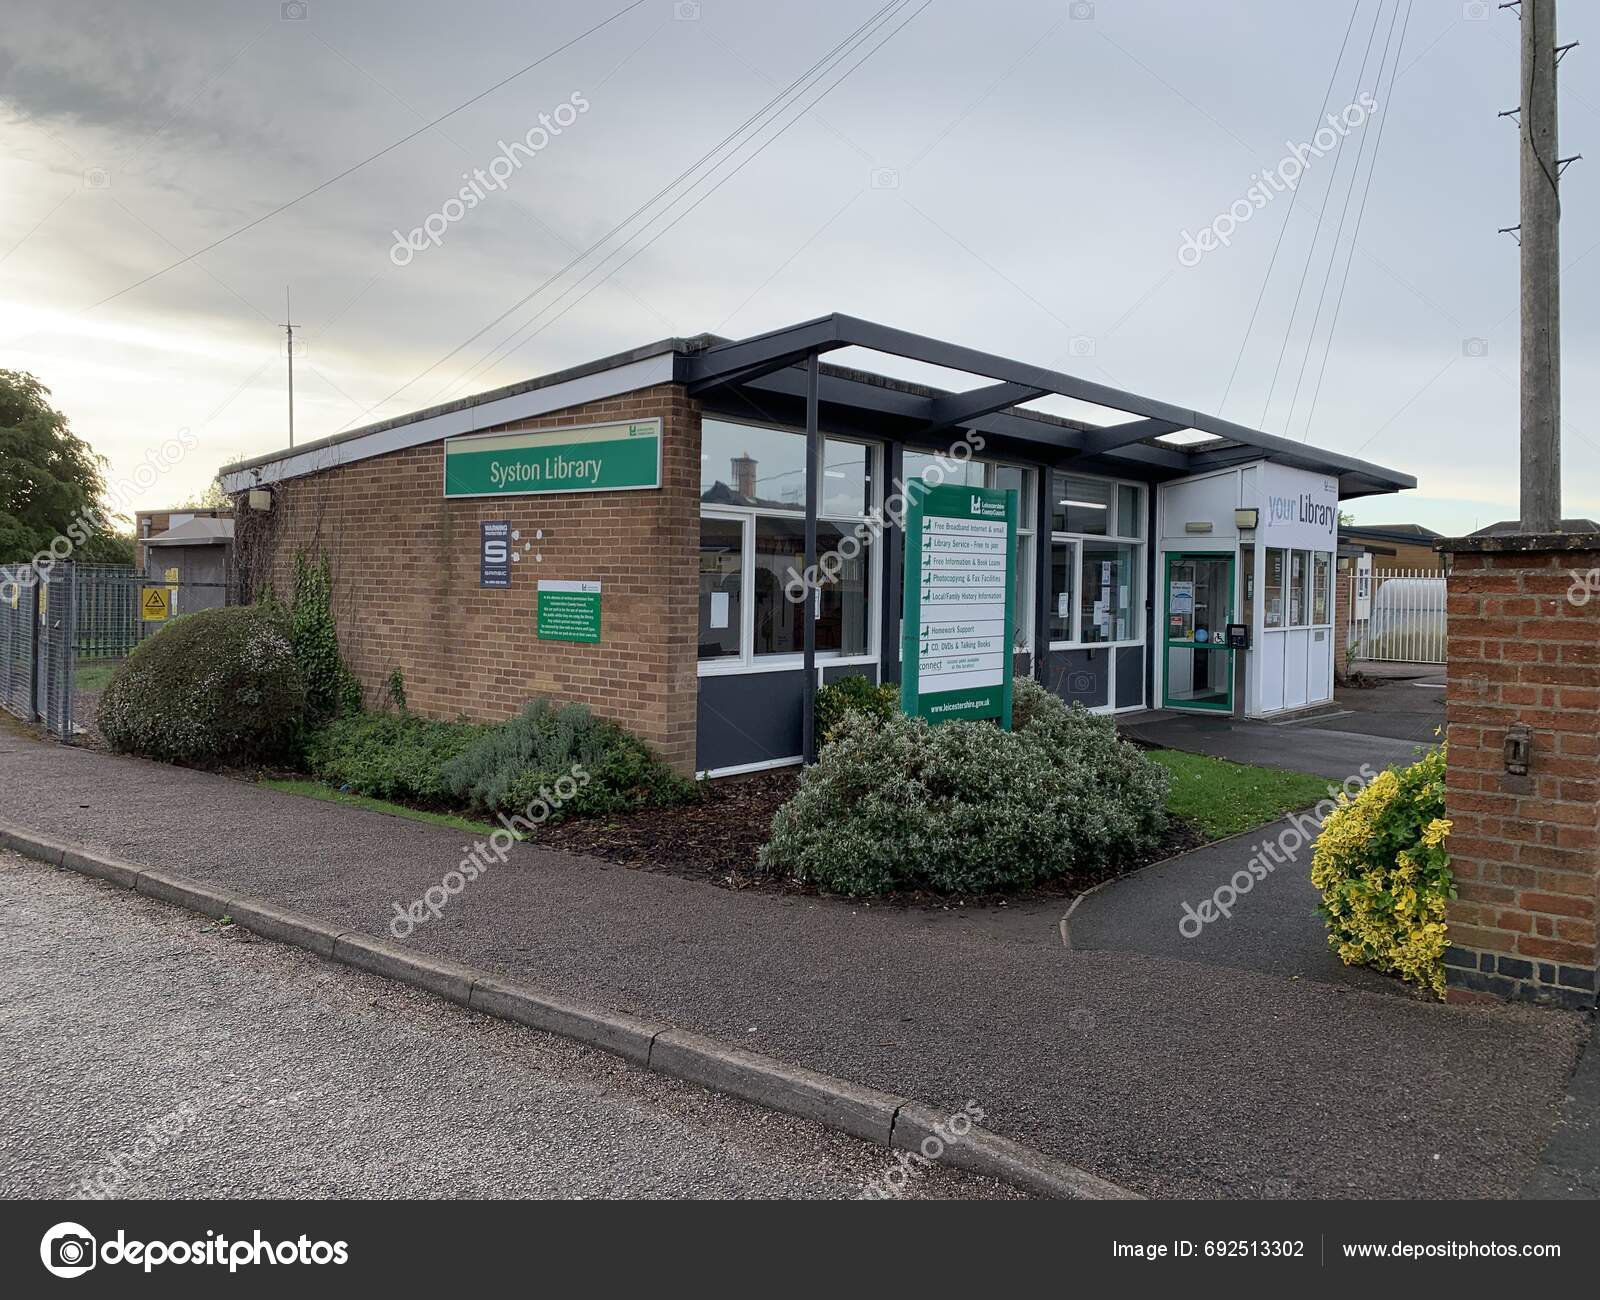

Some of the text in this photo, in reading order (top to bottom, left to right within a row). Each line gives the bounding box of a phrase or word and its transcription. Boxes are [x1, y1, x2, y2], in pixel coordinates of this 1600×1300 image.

[490, 456, 602, 488] Syston Library
[1268, 493, 1336, 535] your Library
[934, 521, 945, 530] Free
[945, 522, 970, 531] Broadband
[933, 539, 951, 549] Library
[952, 540, 970, 549] Service
[973, 541, 984, 549] Free
[933, 557, 944, 566] Free
[945, 557, 972, 566] Information
[977, 558, 988, 567] Book
[933, 574, 966, 583] Photocopying
[972, 574, 981, 583] Fax
[961, 592, 978, 601] History
[978, 592, 1002, 600] Information
[931, 625, 975, 635] Homework Support
[960, 640, 976, 650] Talking
[977, 640, 991, 649] Books
[930, 698, 991, 713] www.leicestershire.gov.uk
